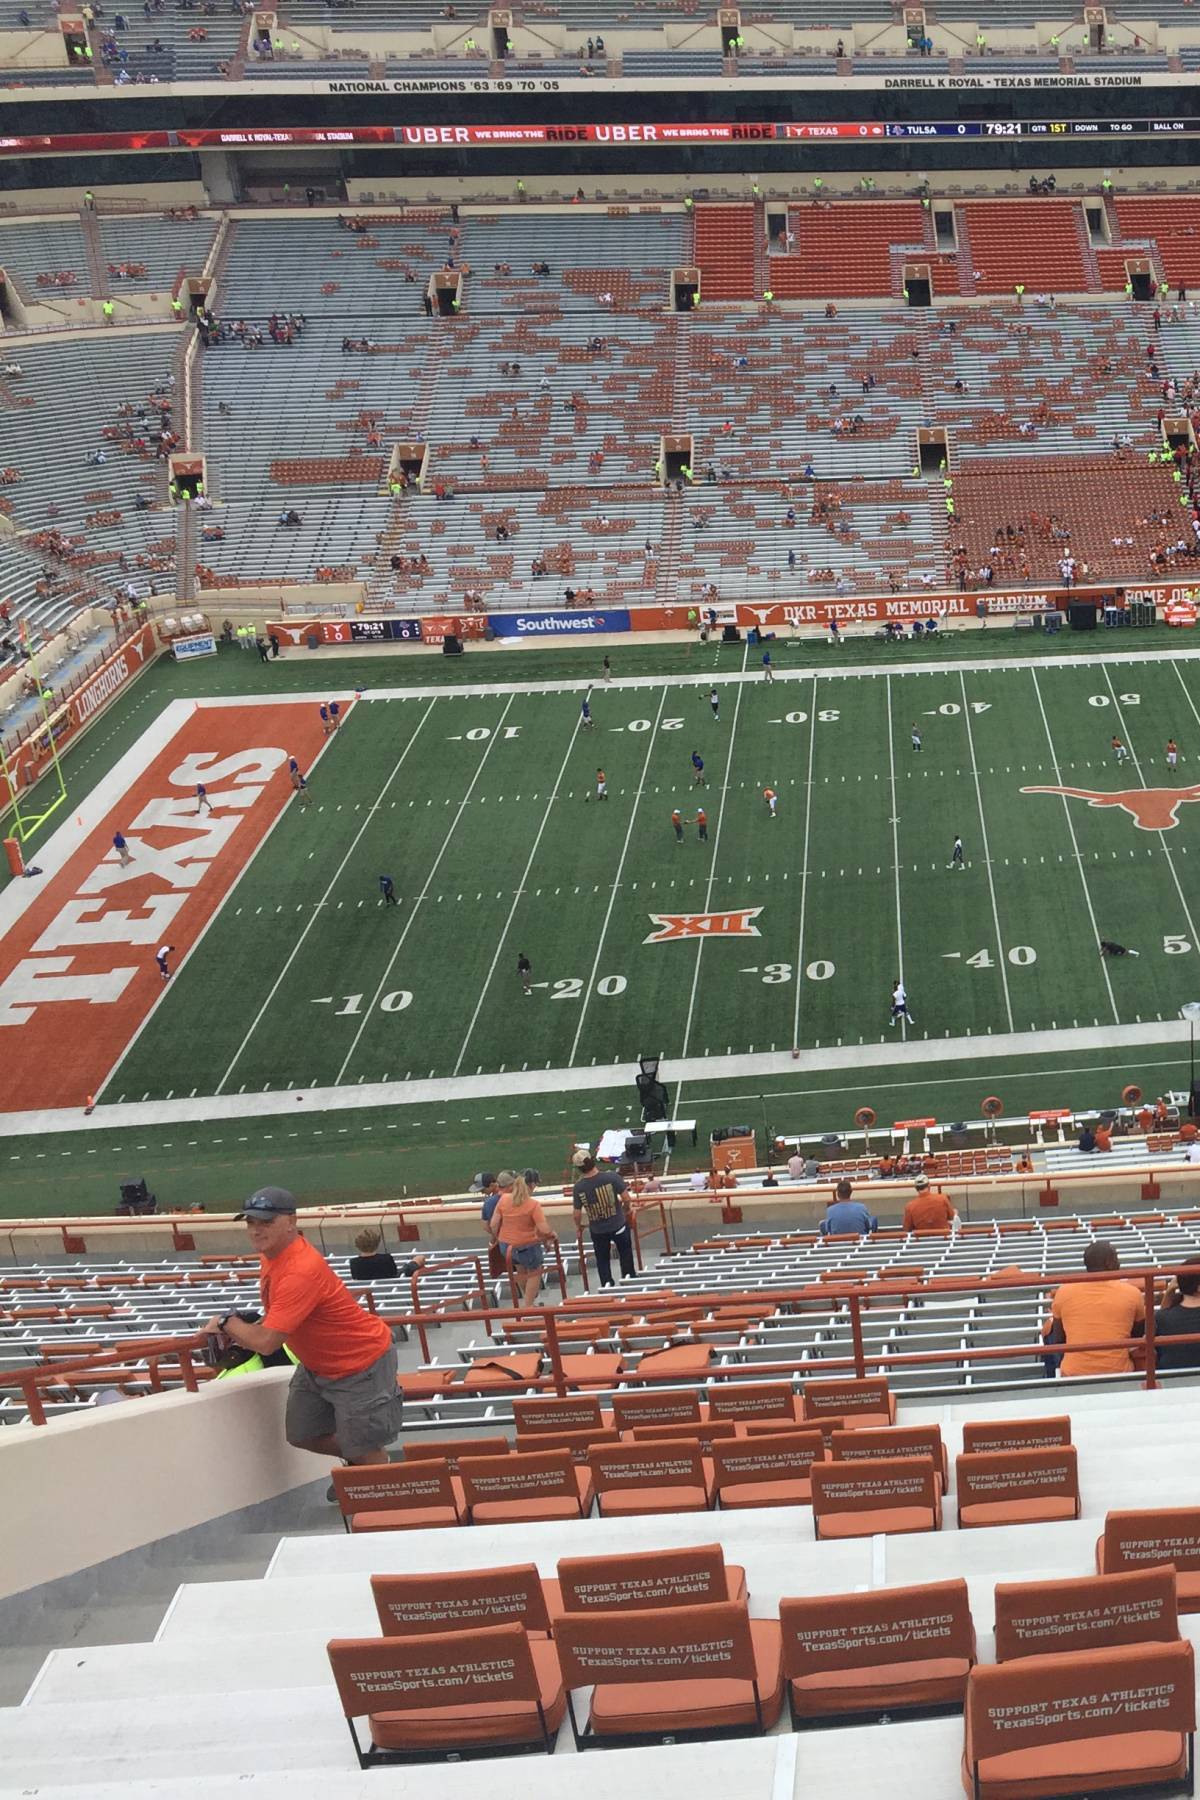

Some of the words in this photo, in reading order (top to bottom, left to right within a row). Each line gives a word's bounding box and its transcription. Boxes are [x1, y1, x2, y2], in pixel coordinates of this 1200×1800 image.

[329, 82, 389, 92] NATIONAL
[394, 82, 466, 91] CHAMPIONS
[470, 82, 489, 91] '63
[494, 82, 513, 90] '69
[517, 81, 535, 90] '70
[540, 81, 559, 90] '05
[885, 78, 935, 88] DARRELL
[938, 78, 945, 87] K
[949, 78, 984, 87] ROYAL
[994, 78, 1031, 87] TEXAS
[1034, 77, 1090, 86] MEMORIAL
[1094, 77, 1142, 86] STADIUM
[406, 128, 470, 142] UBER
[546, 126, 588, 141] RIDE
[596, 126, 657, 140] UBER
[663, 129, 678, 137] WE
[732, 125, 772, 138] RIDE
[860, 126, 867, 135] 0
[907, 126, 936, 134] TULSA
[958, 125, 966, 134] 0
[986, 124, 1021, 134] 79:21
[1050, 124, 1067, 133] 1ST
[784, 603, 877, 620] DKR-TEXAS
[886, 599, 969, 616] MEMORIAL
[517, 616, 596, 631] Southwest
[425, 636, 445, 644] TEXA
[75, 655, 129, 722] LONGHORNS
[938, 701, 993, 715] 40
[1088, 693, 1141, 707] 50
[628, 717, 685, 733] 20
[785, 709, 841, 724] 30
[466, 726, 523, 741] 10
[0, 747, 289, 1026] TEXAS
[965, 946, 1037, 968] 40
[761, 960, 835, 984] 30
[550, 975, 627, 1000] 20
[334, 990, 414, 1015] 10
[1120, 1539, 1161, 1550] SUPPORT
[1163, 1536, 1194, 1546] TEXAS
[574, 1582, 617, 1594] SUPPORT
[620, 1578, 653, 1590] TEXAS
[656, 1571, 710, 1586] ATHLETICS
[579, 1581, 708, 1604] TexasSports.com/tickets
[389, 1601, 432, 1611] SUPPORT
[436, 1598, 468, 1609] TEXAS
[472, 1593, 527, 1606] ATHLETICS
[394, 1602, 526, 1622] TexasSports.com/tickets
[1012, 1614, 1060, 1627] SUPPORT
[1063, 1610, 1100, 1623] TEXAS
[1103, 1599, 1163, 1618] ATHLETICS
[797, 1627, 846, 1641] SUPPORT
[850, 1623, 889, 1636] TEXAS
[891, 1614, 954, 1632] ATHLETICS
[1016, 1610, 1160, 1640] TexasSports.com/tickets
[802, 1626, 951, 1652] TexasSports.com/tickets
[572, 1646, 623, 1656] SUPPORT
[628, 1644, 667, 1655] TEXAS
[672, 1640, 733, 1653] ATHLETICS
[578, 1650, 731, 1667] TexasSports.com/tickets
[350, 1670, 401, 1680] SUPPORT
[406, 1667, 445, 1677] TEXAS
[450, 1659, 515, 1673] ATHLETICS
[357, 1671, 513, 1693] TexasSports.com/tickets
[988, 1701, 1048, 1718] SUPPORT
[1052, 1694, 1097, 1711] TEXAS
[1101, 1684, 1175, 1705] ATHLETICS
[994, 1698, 1170, 1731] TexasSports.com/tickets
